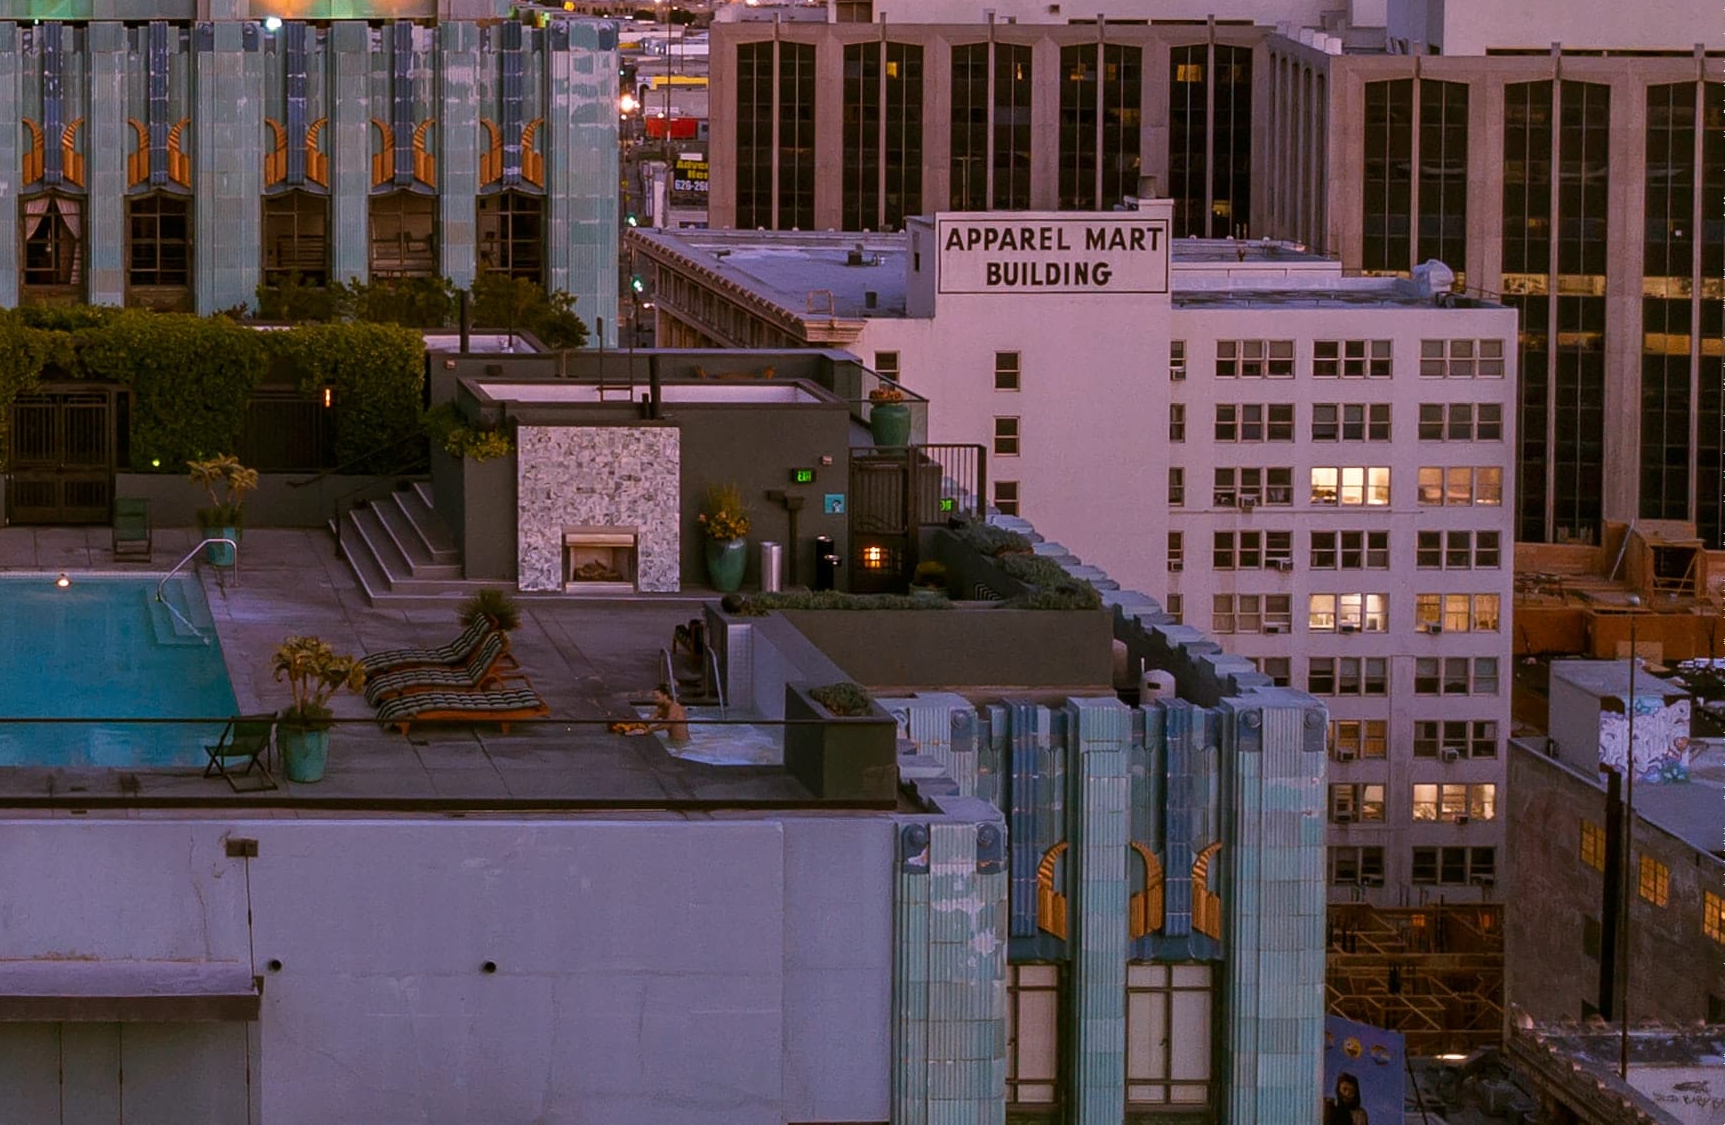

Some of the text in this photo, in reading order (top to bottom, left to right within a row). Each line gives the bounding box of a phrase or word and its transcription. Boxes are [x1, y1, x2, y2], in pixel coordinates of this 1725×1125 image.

[944, 227, 1164, 252] APPAREL MART
[985, 261, 1113, 286] BUILDING
